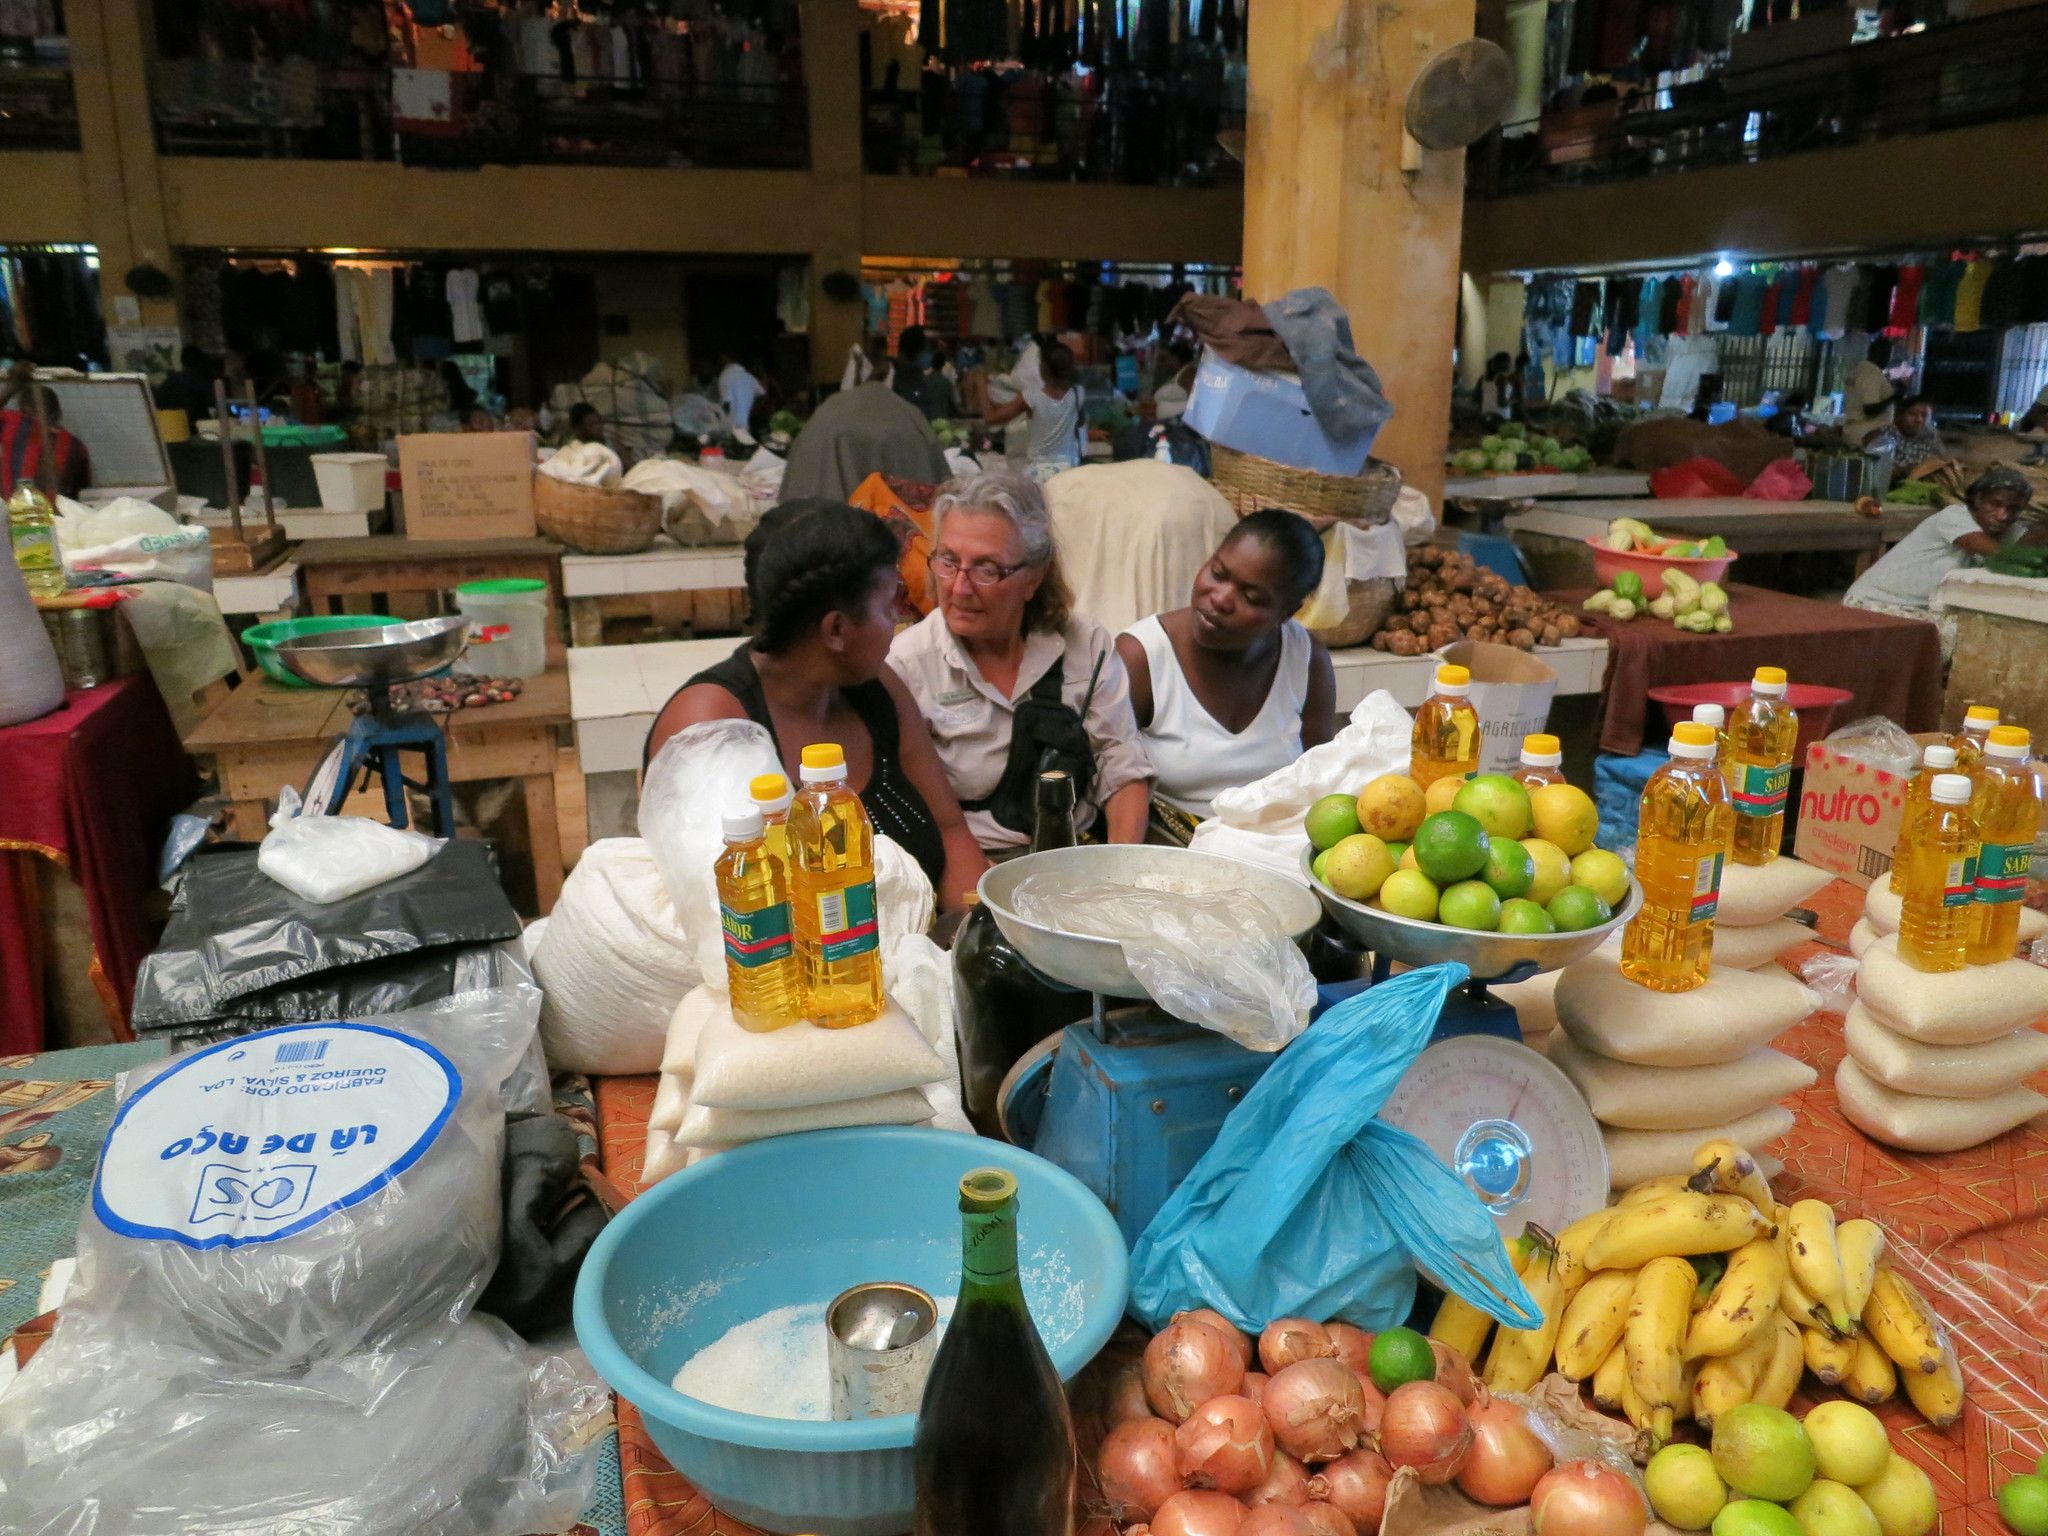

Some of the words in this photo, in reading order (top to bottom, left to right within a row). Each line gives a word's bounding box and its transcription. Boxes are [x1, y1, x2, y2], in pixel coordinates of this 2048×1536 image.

[1800, 785, 1881, 826] nutro
[1811, 827, 1858, 856] crackers
[721, 911, 753, 940] SABOR
[285, 1076, 384, 1096] FABRICADO
[294, 1072, 306, 1081] &
[308, 1067, 387, 1080] QUEIROZ
[160, 1124, 248, 1161] AÇO
[258, 1132, 317, 1155] DE
[330, 1124, 379, 1157] LÃ
